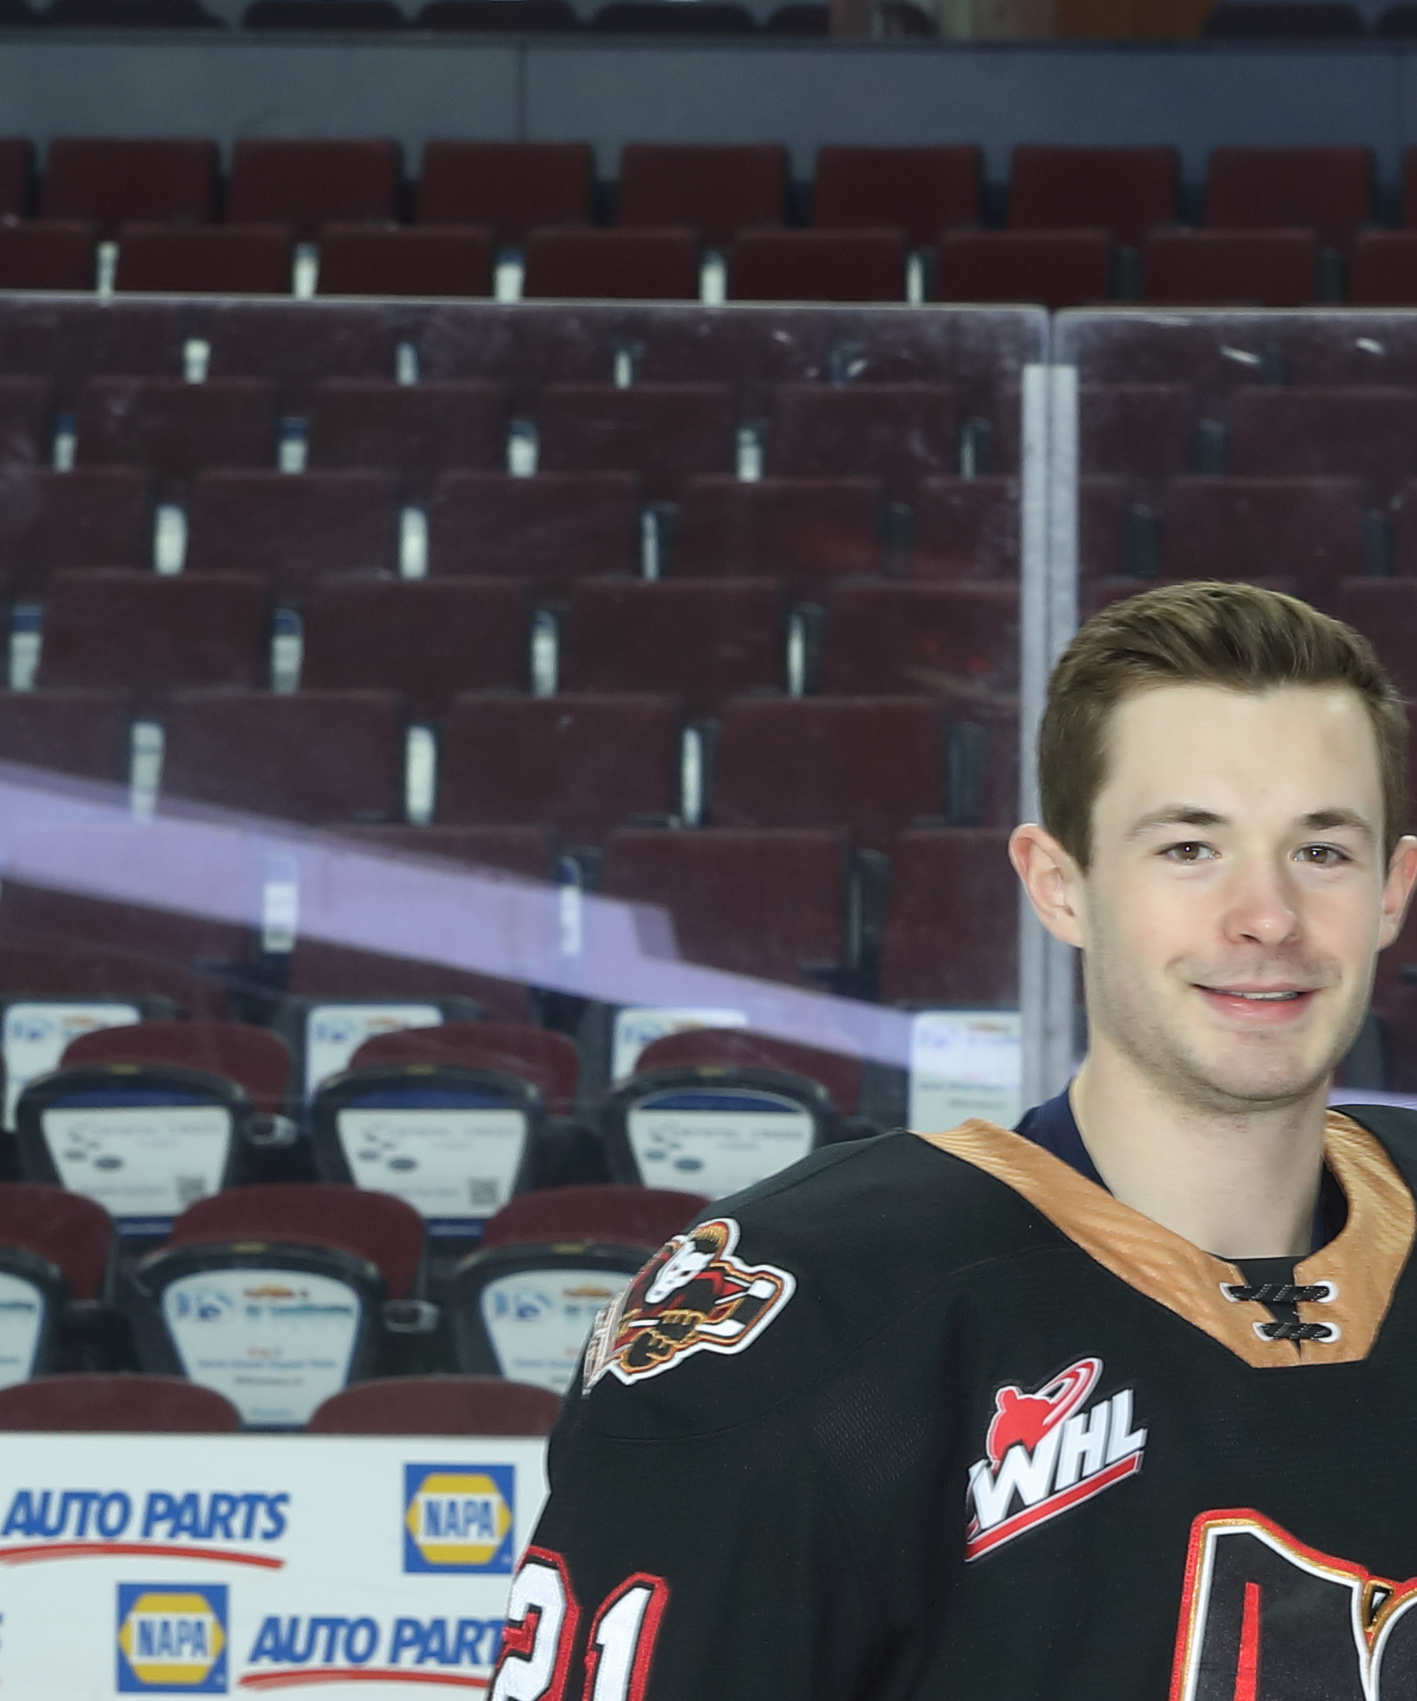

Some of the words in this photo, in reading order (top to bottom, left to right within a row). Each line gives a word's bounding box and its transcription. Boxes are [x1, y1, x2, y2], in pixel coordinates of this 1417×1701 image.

[968, 1389, 1148, 1530] WHL
[1, 1489, 132, 1539] AUTO
[141, 1491, 290, 1541] PARTS
[423, 1498, 497, 1540] NAPA
[136, 1618, 209, 1658] NAPA
[248, 1616, 379, 1664] AUTO
[389, 1618, 506, 1665] PART
